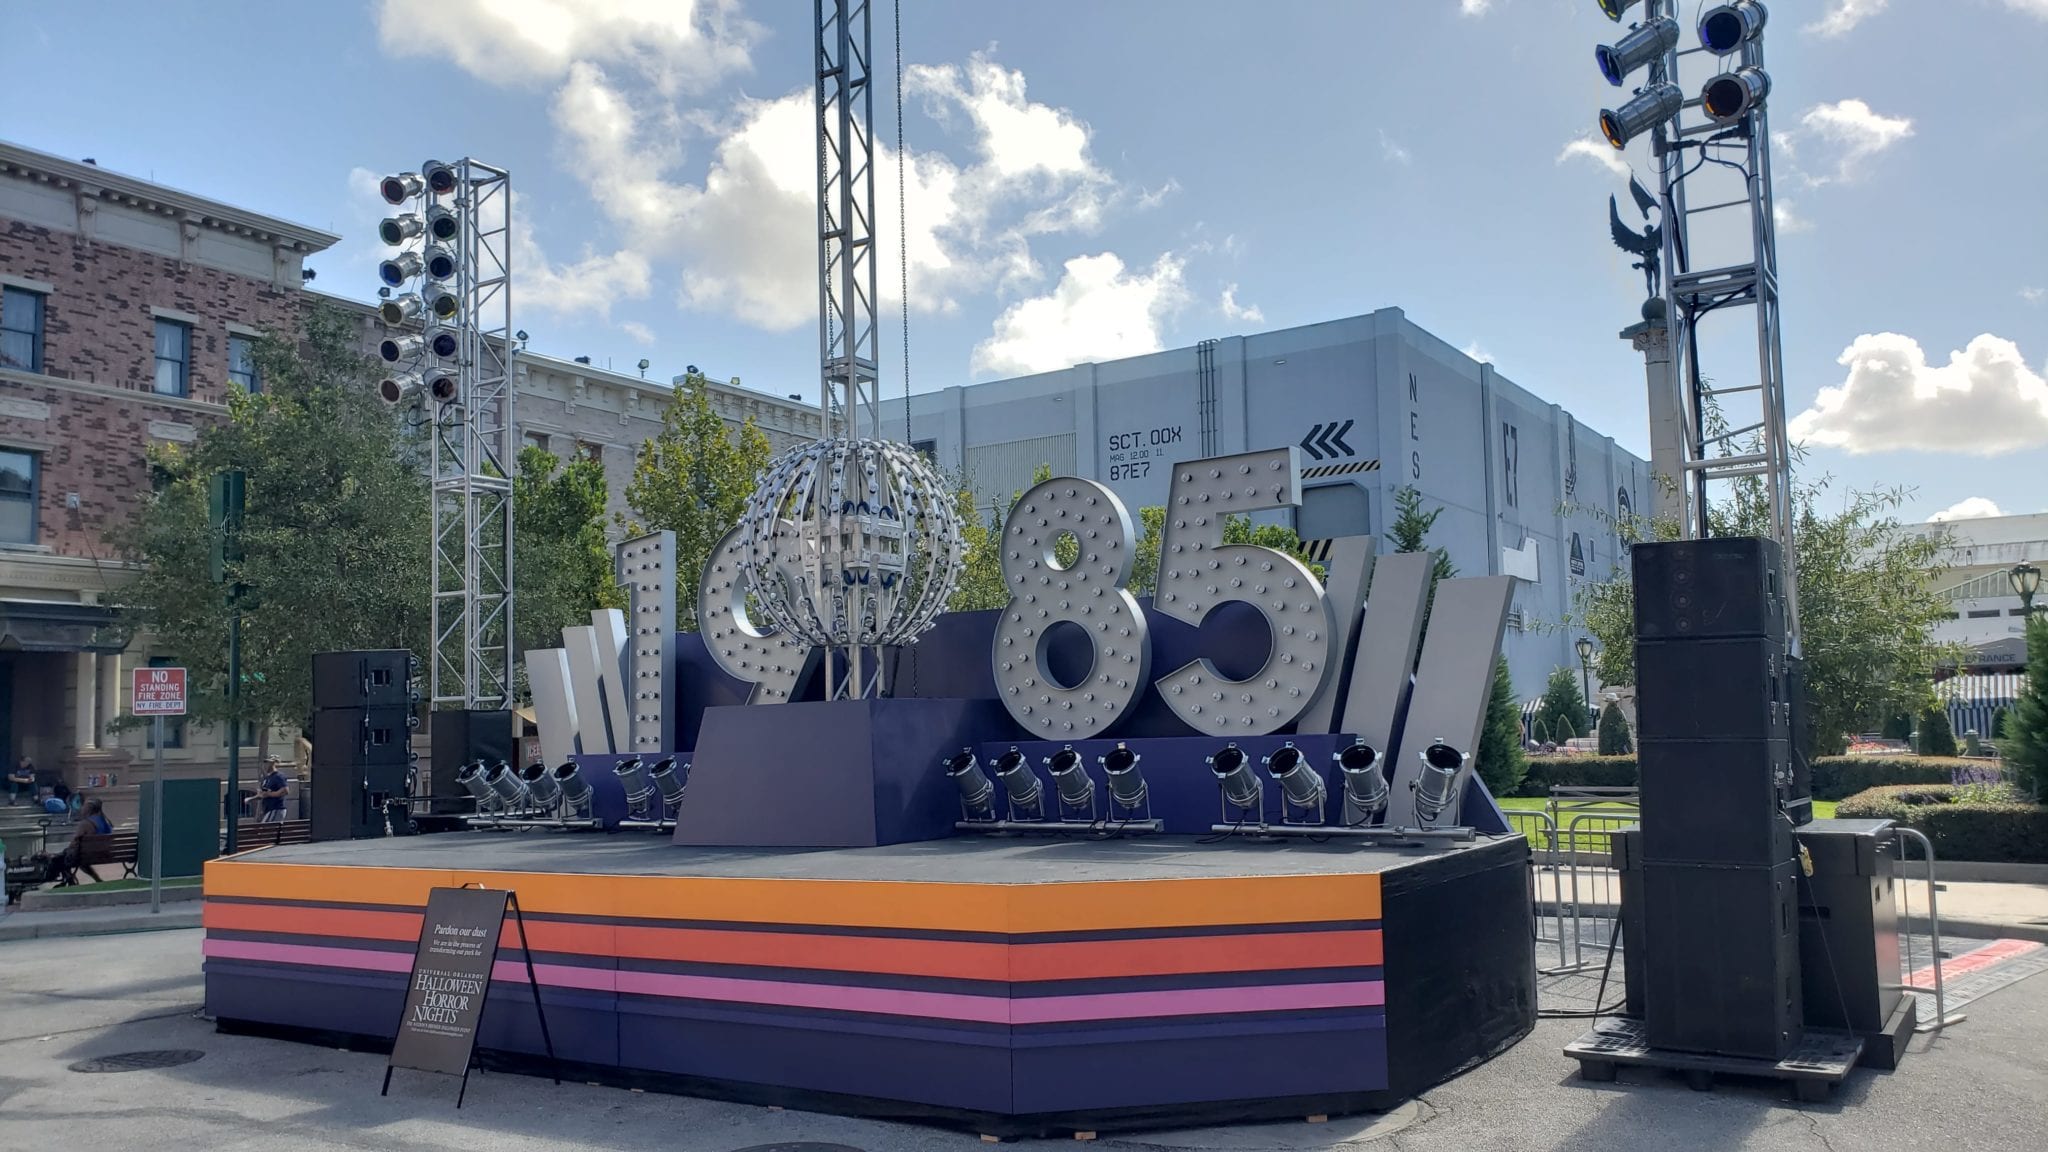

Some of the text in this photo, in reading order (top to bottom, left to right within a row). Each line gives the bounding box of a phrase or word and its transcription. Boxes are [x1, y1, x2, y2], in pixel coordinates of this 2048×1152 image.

[1109, 431, 1146, 451] SCT.
[1110, 461, 1151, 481] 87E7
[152, 670, 168, 683] NO
[138, 691, 182, 700] FIRE ZONE
[140, 683, 180, 691] STANDING
[434, 923, 488, 938] Pardon our dust
[418, 968, 451, 977] UNIVERSAL
[415, 974, 483, 995] HALLOWEEN
[423, 990, 469, 1010] HORROR
[412, 1005, 459, 1024] NIGHTS
